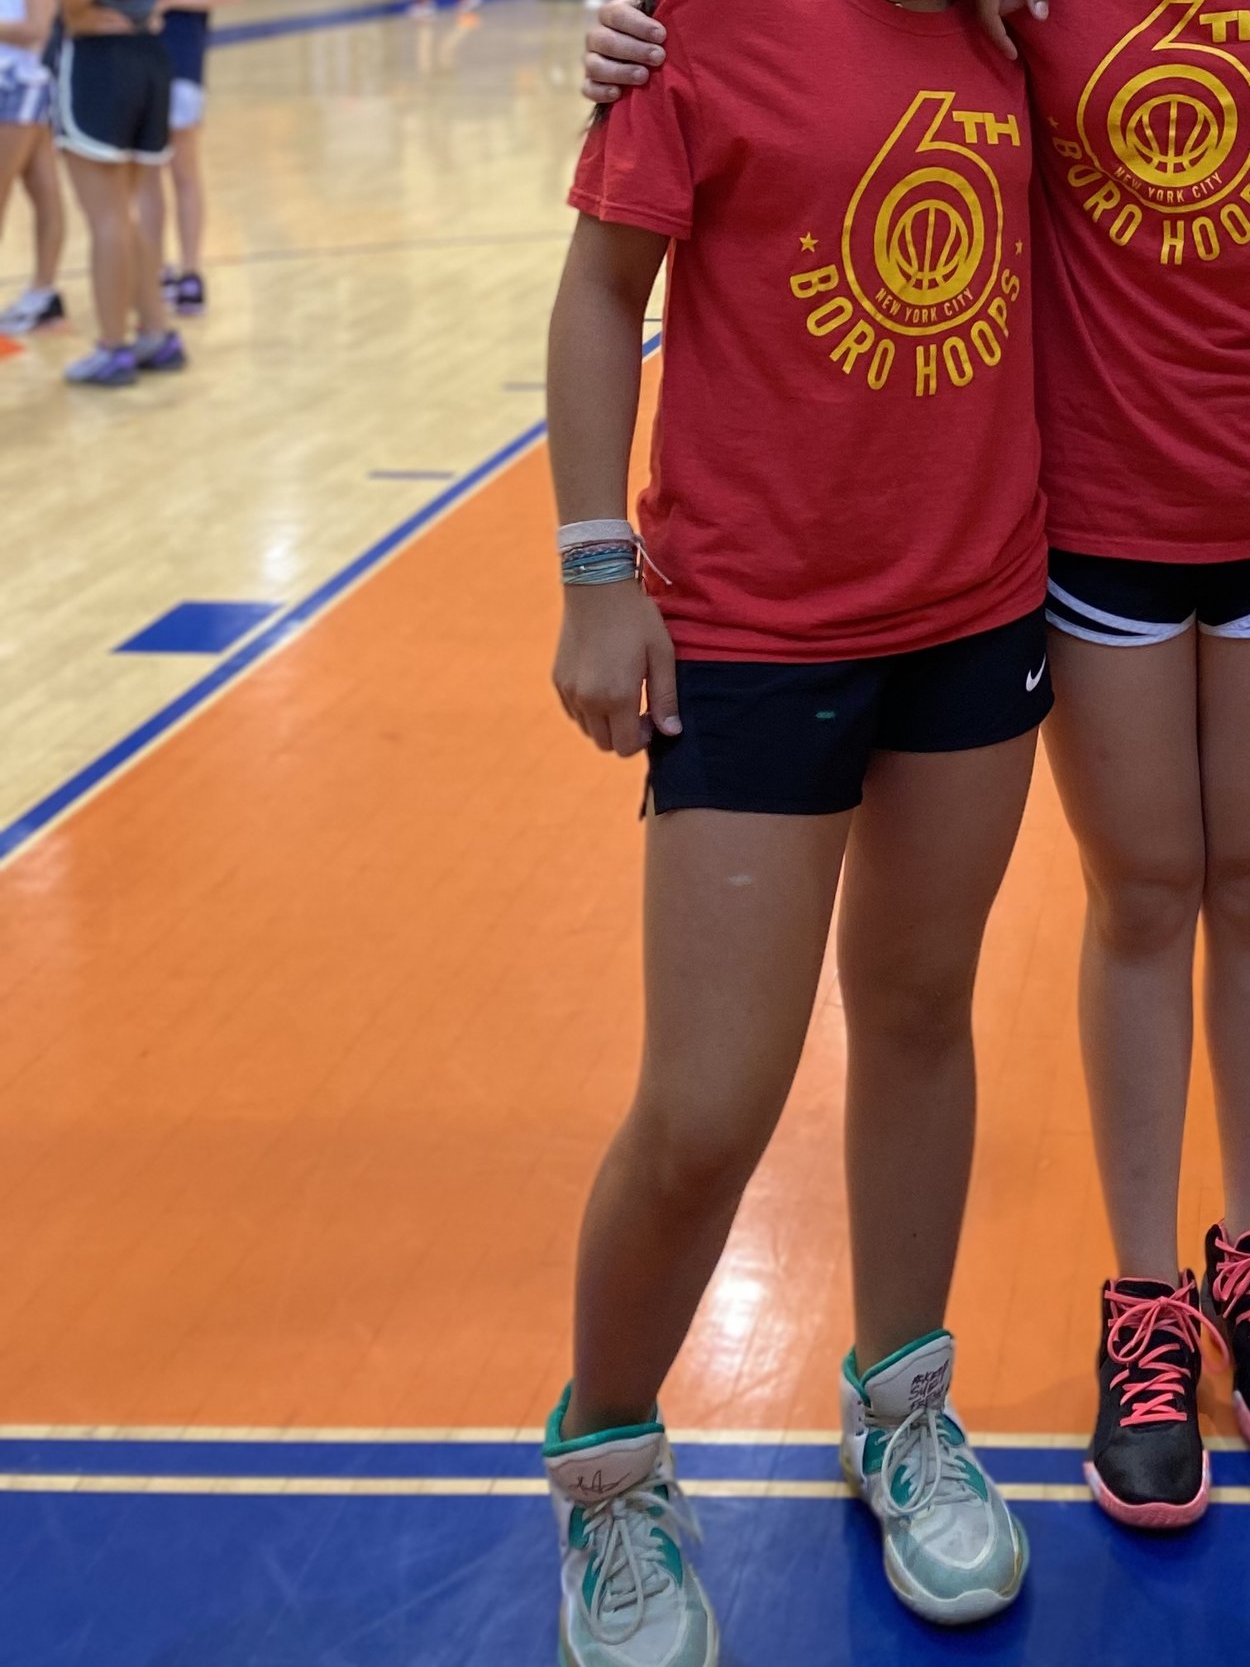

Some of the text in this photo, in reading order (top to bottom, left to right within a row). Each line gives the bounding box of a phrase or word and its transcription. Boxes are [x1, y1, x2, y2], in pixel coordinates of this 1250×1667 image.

[841, 90, 1021, 337] 6TH
[1052, 136, 1143, 247] BORO
[1147, 186, 1185, 204] YORK
[1191, 171, 1223, 199] CITY
[789, 263, 1021, 397] BORO HOOPS
[875, 287, 974, 324] NEW YORK CITY
